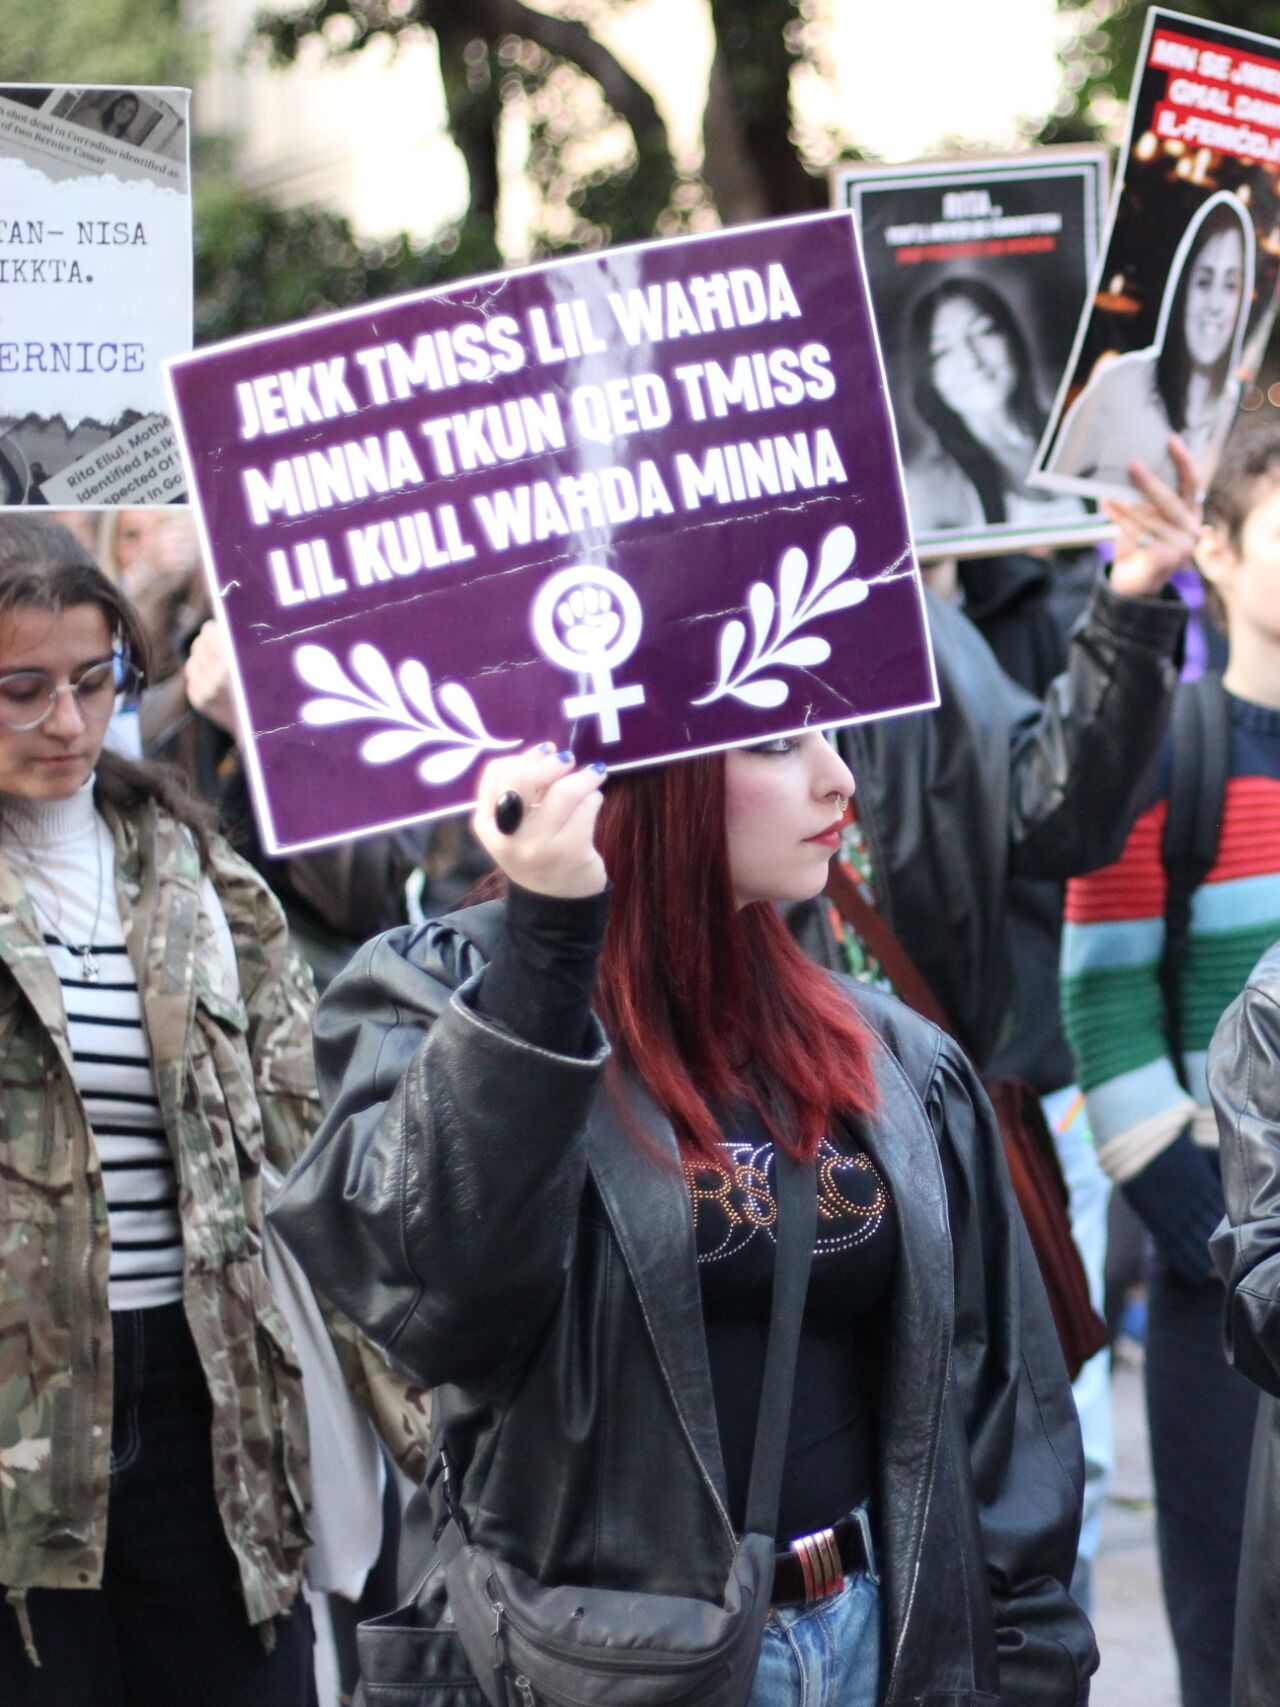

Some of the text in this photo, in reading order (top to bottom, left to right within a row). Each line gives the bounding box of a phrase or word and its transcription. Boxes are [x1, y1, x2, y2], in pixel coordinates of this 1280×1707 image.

[14, 125, 33, 138] two
[29, 114, 53, 131] dead
[56, 124, 65, 137] in
[119, 149, 166, 176] identified
[167, 170, 179, 179] as
[77, 221, 147, 245] NISA
[236, 263, 802, 439] JEKK TMISS LIL WAĦDA
[243, 344, 836, 525] MINNA TKUN QED TMISS
[67, 466, 95, 488] Rita
[76, 456, 141, 502] Identified
[143, 446, 161, 462] As
[147, 486, 162, 501] In
[268, 429, 848, 607] LIL KULL WAĦDA MINNA
